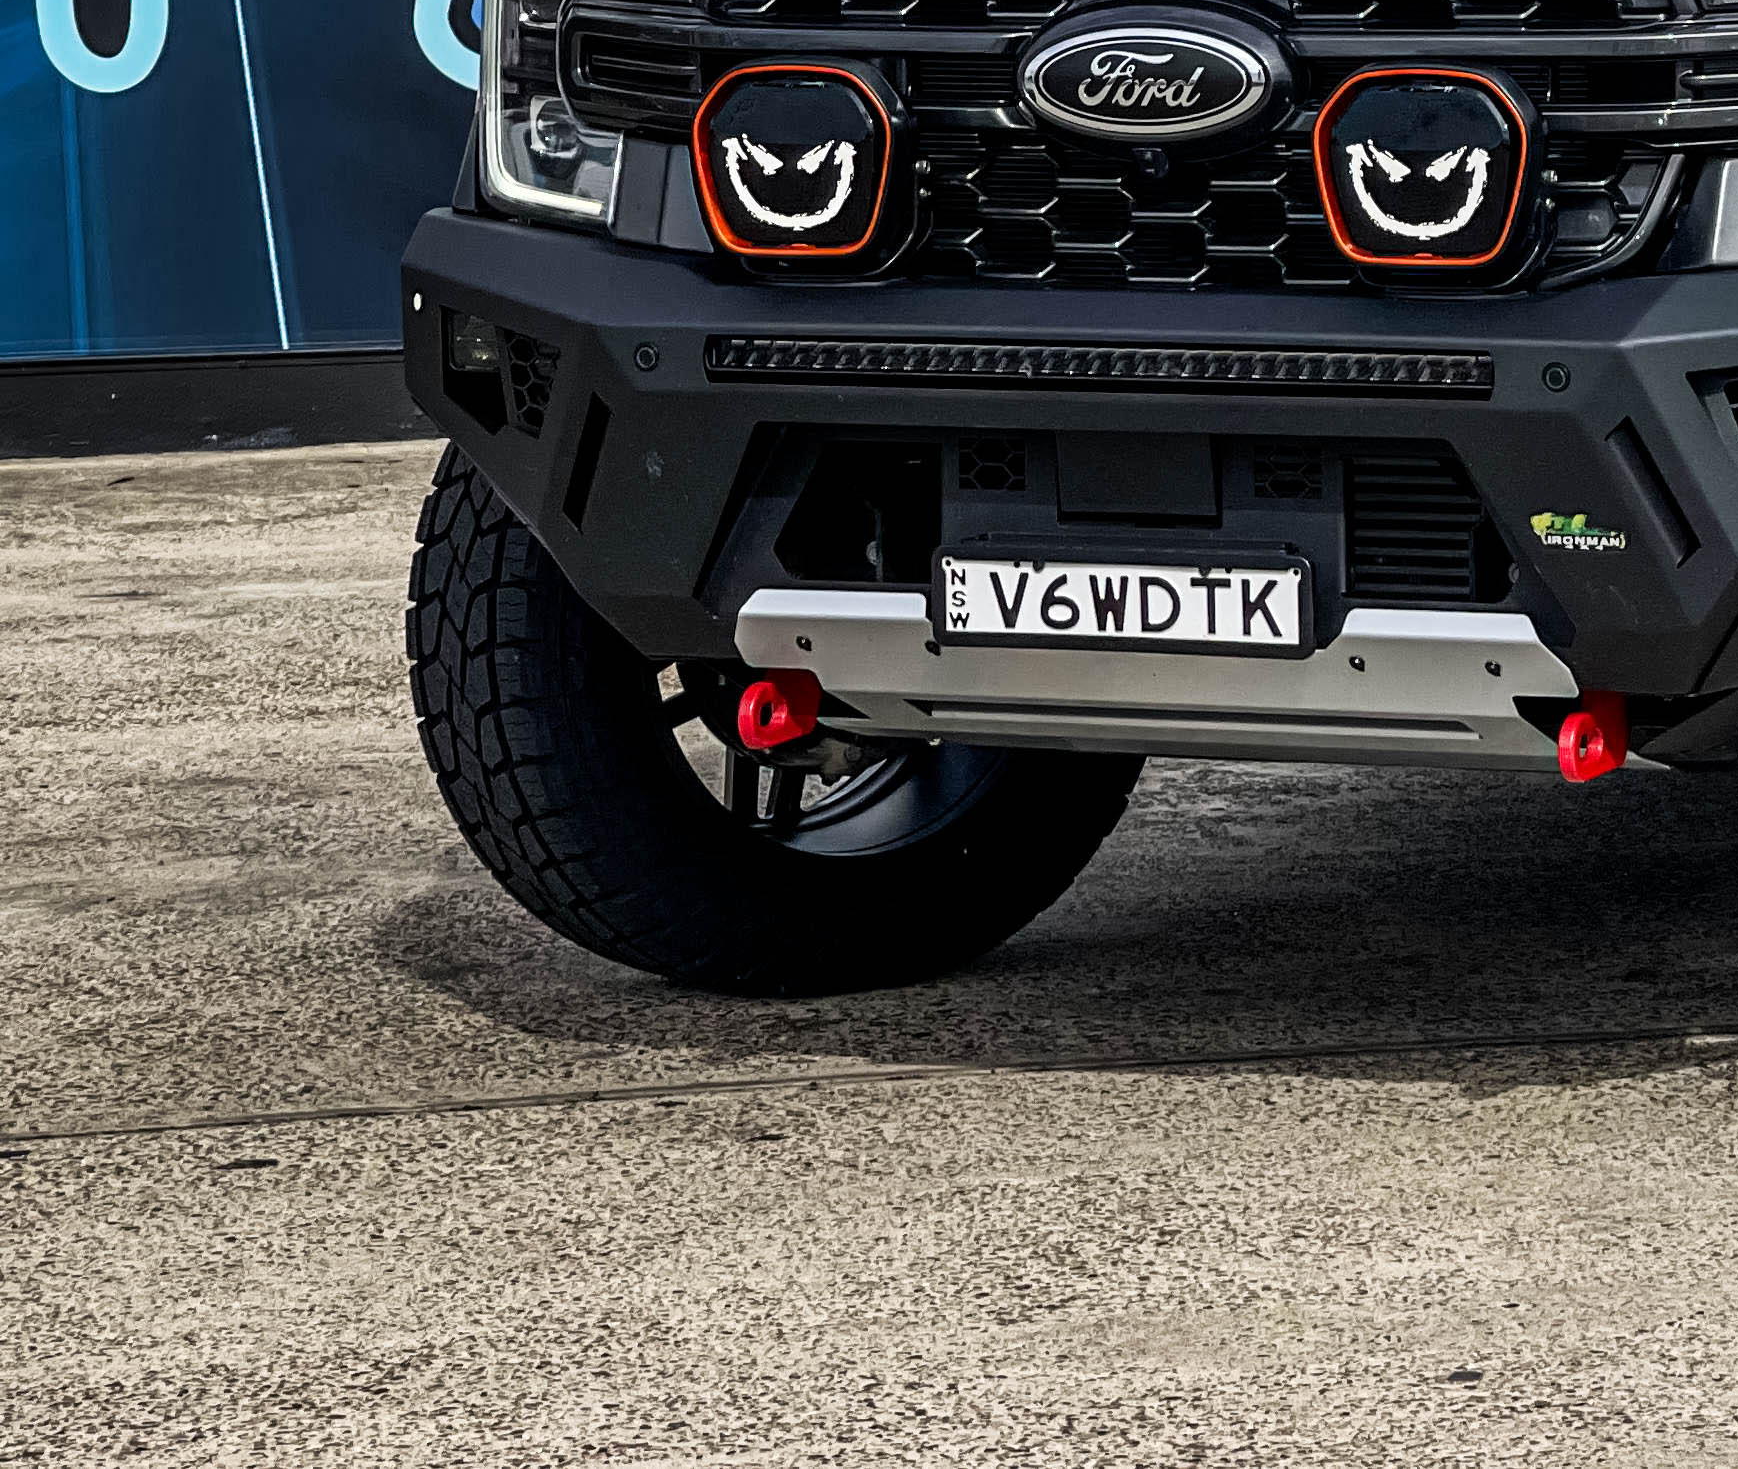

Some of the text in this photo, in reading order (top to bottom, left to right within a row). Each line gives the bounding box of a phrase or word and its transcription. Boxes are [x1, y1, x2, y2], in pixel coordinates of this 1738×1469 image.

[1077, 50, 1205, 108] Ford
[1546, 534, 1621, 548] IRONMAN
[988, 570, 1283, 638] V6WDTK
